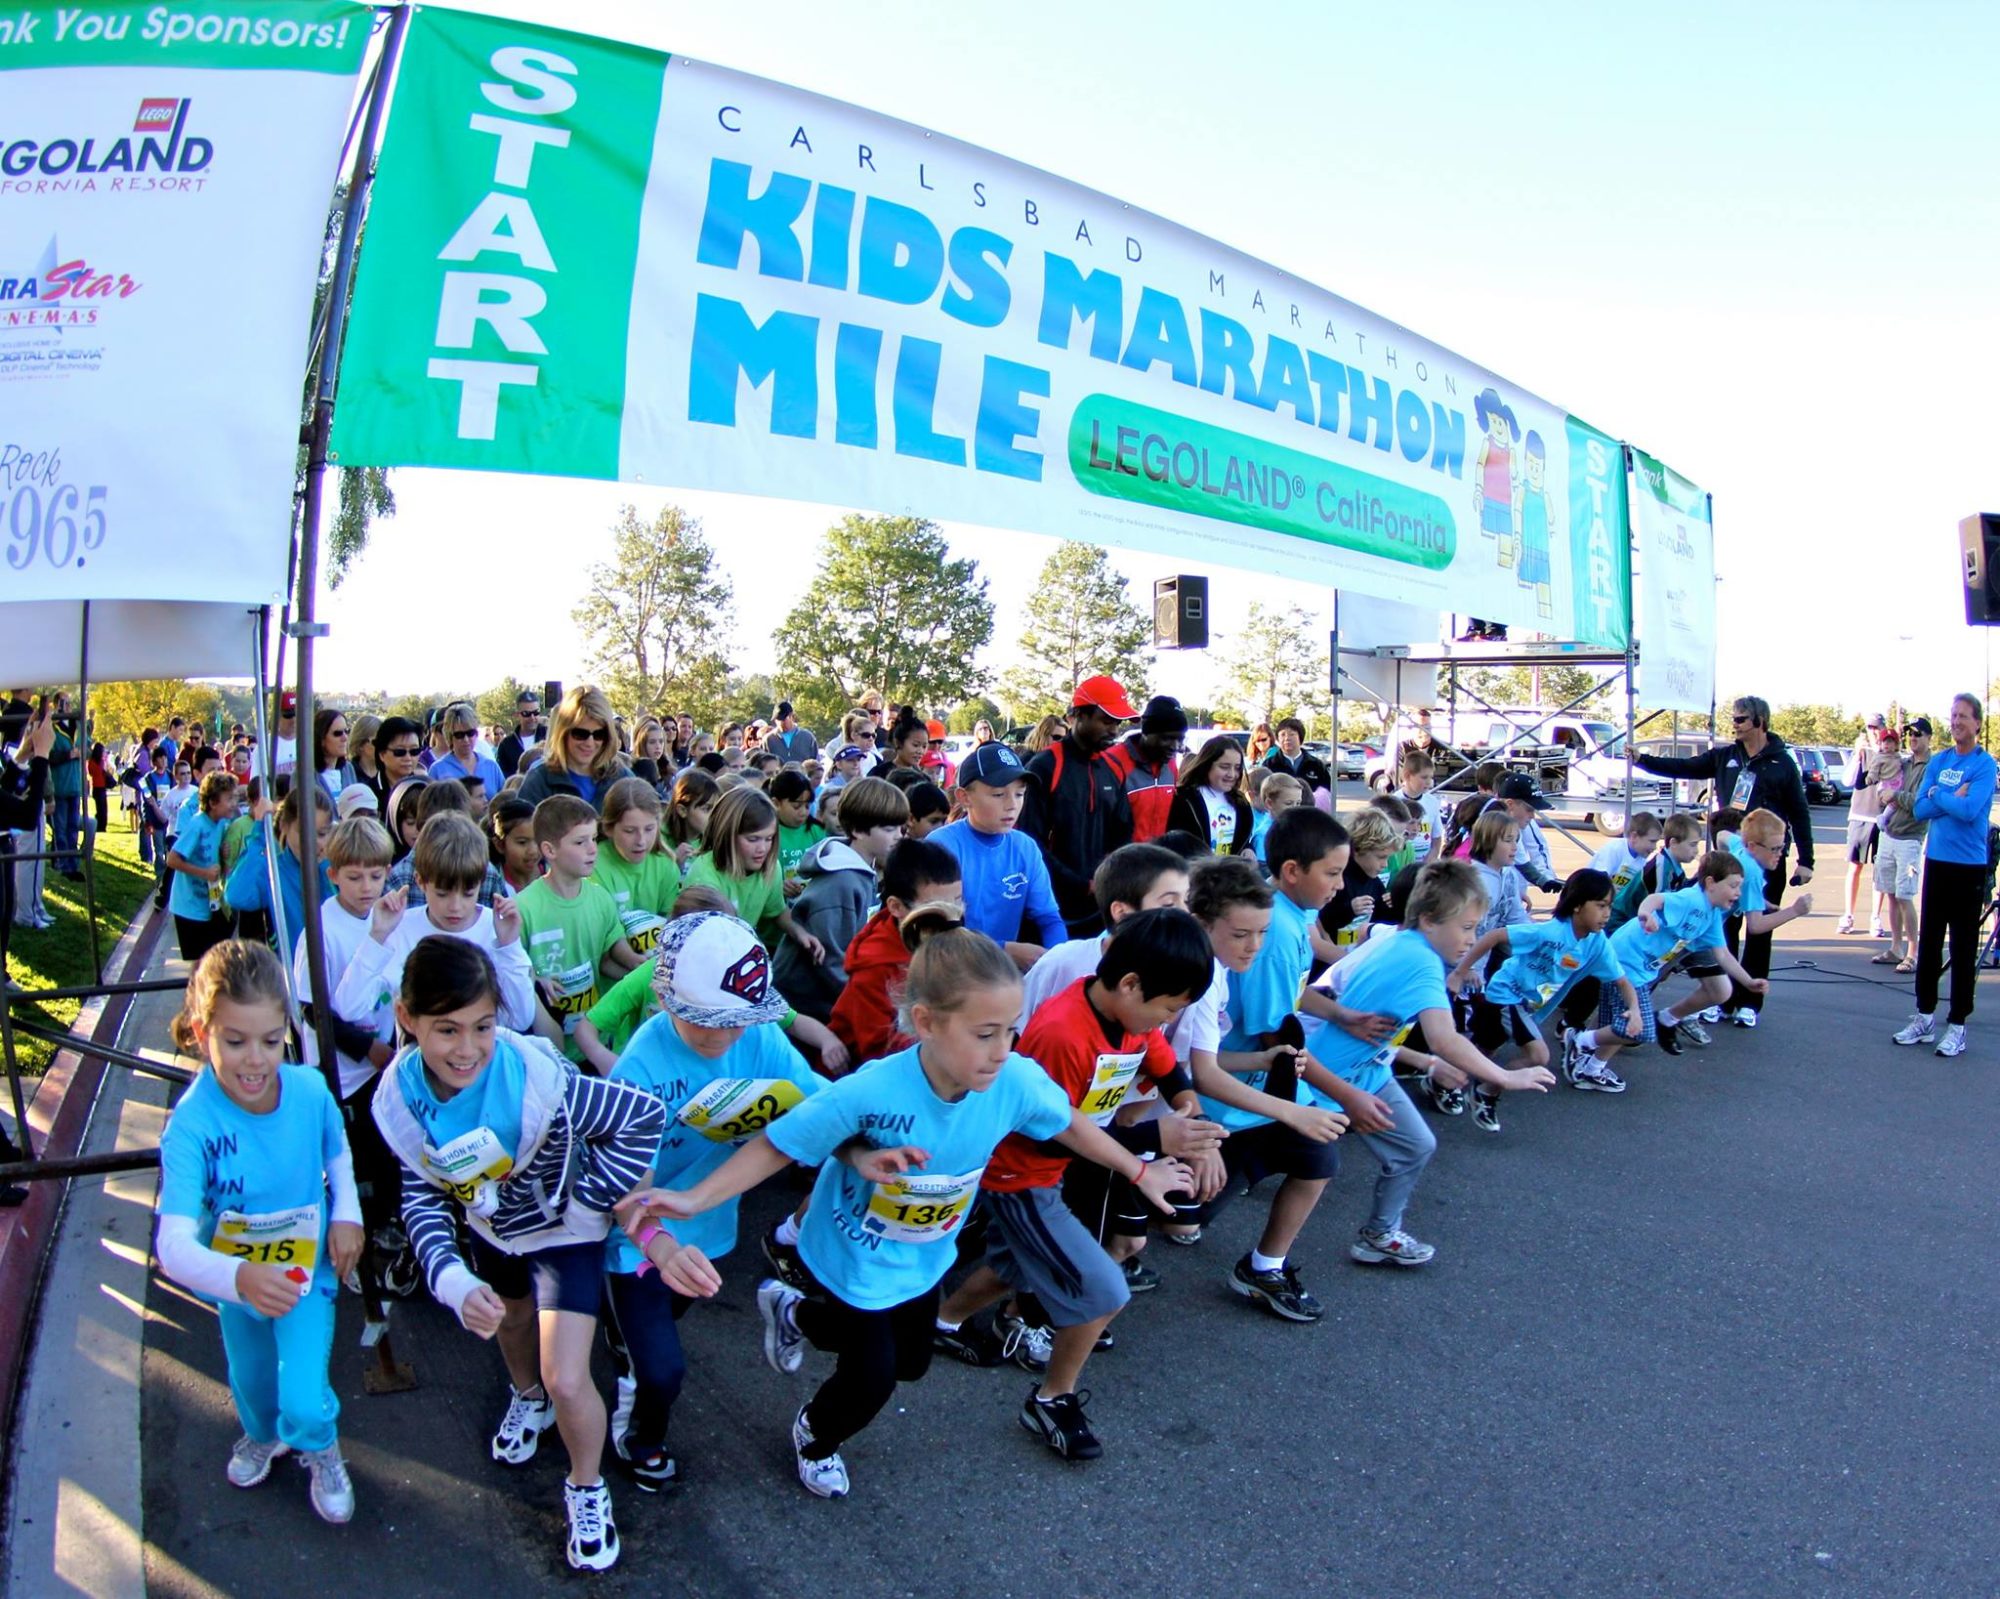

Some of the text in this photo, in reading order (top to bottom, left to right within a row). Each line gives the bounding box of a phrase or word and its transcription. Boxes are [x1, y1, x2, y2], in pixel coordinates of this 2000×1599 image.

[55, 9, 131, 42] You
[142, 7, 349, 49] Sponsors!
[140, 108, 173, 121] LEGO
[0, 98, 214, 176] GOLAND
[110, 177, 208, 193] RESORT
[427, 46, 579, 441] START
[717, 106, 1457, 396] CARLSBAD MARATHON
[0, 259, 143, 301] RA Star
[696, 157, 1466, 480] KIDS MARATHON
[687, 291, 1051, 483] MILE
[0, 444, 61, 490] Rock
[1315, 481, 1448, 555] California
[1584, 438, 1613, 638] START
[559, 986, 594, 1014] 277
[702, 1078, 738, 1109] MARATHO
[1095, 1085, 1125, 1110] 46
[721, 1094, 788, 1136] 252
[467, 1136, 490, 1152] MILE
[910, 1182, 959, 1195] MARATHON
[249, 1215, 294, 1228] MARATHON
[294, 1212, 315, 1222] MILE
[895, 1202, 957, 1225] 136
[231, 1238, 296, 1263] 215
